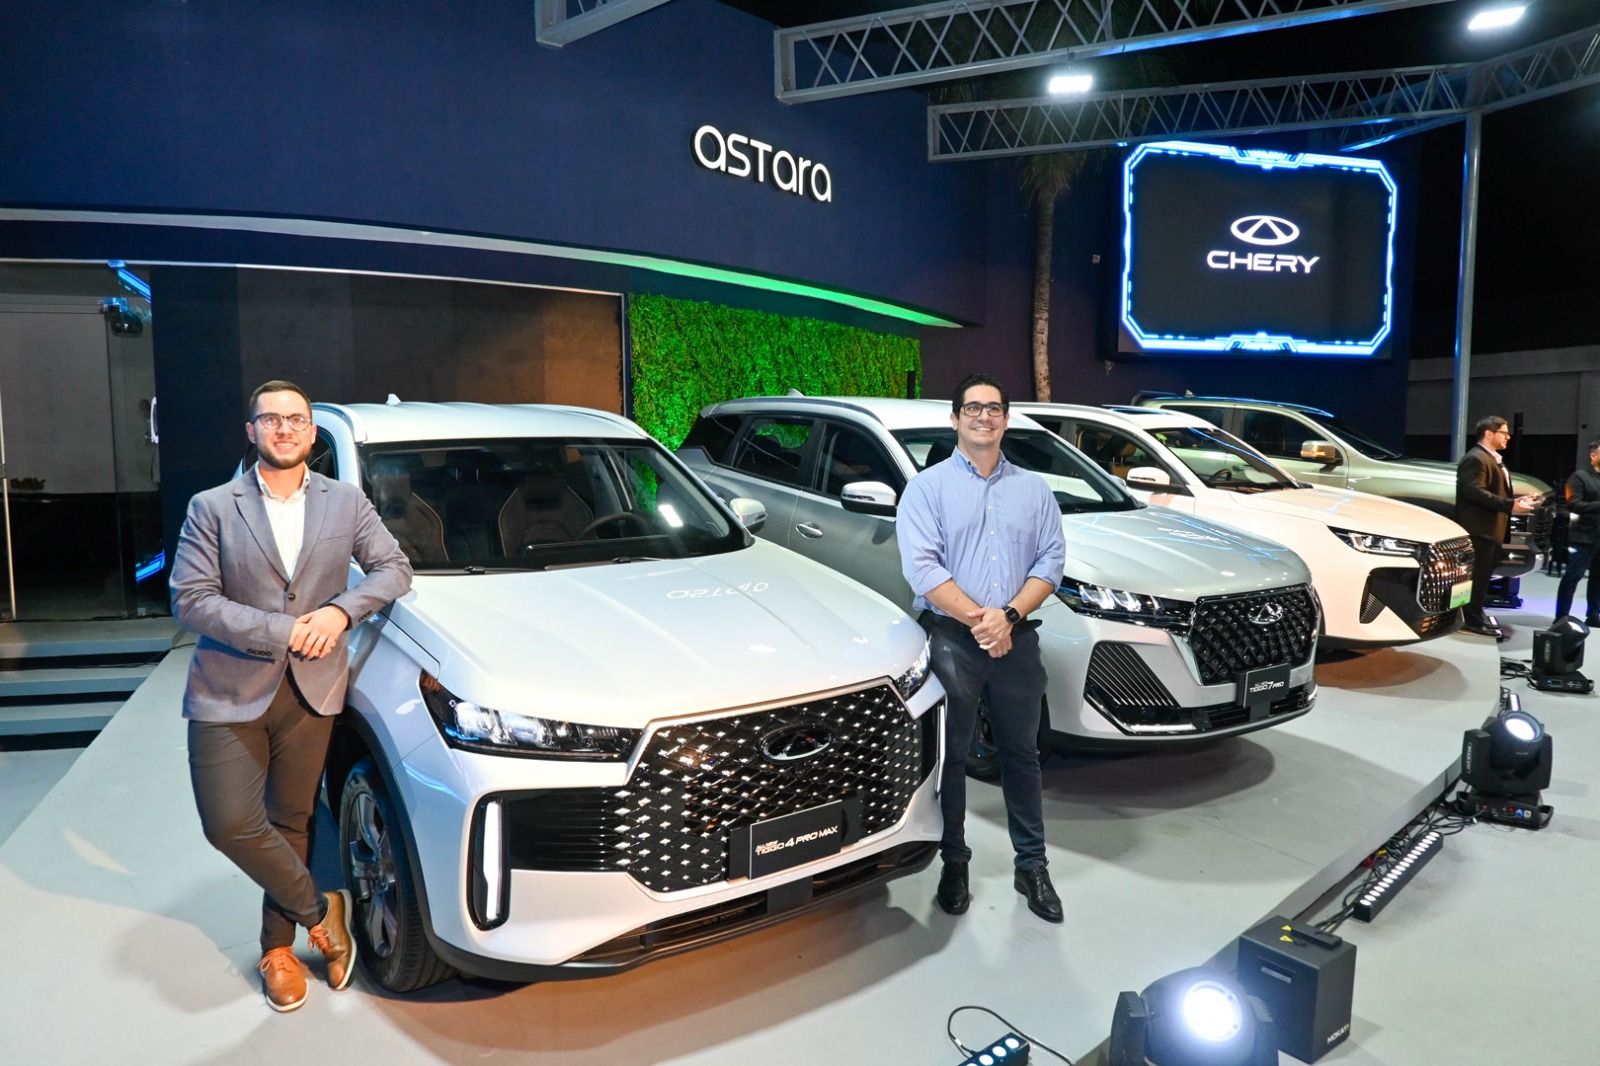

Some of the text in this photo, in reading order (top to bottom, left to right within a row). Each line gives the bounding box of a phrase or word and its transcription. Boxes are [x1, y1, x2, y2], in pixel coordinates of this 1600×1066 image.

[1206, 249, 1321, 274] CHERY
[1249, 684, 1268, 693] TIGGO
[1267, 681, 1274, 690] 7
[755, 825, 838, 855] TIGGO 4 PRO MAX
